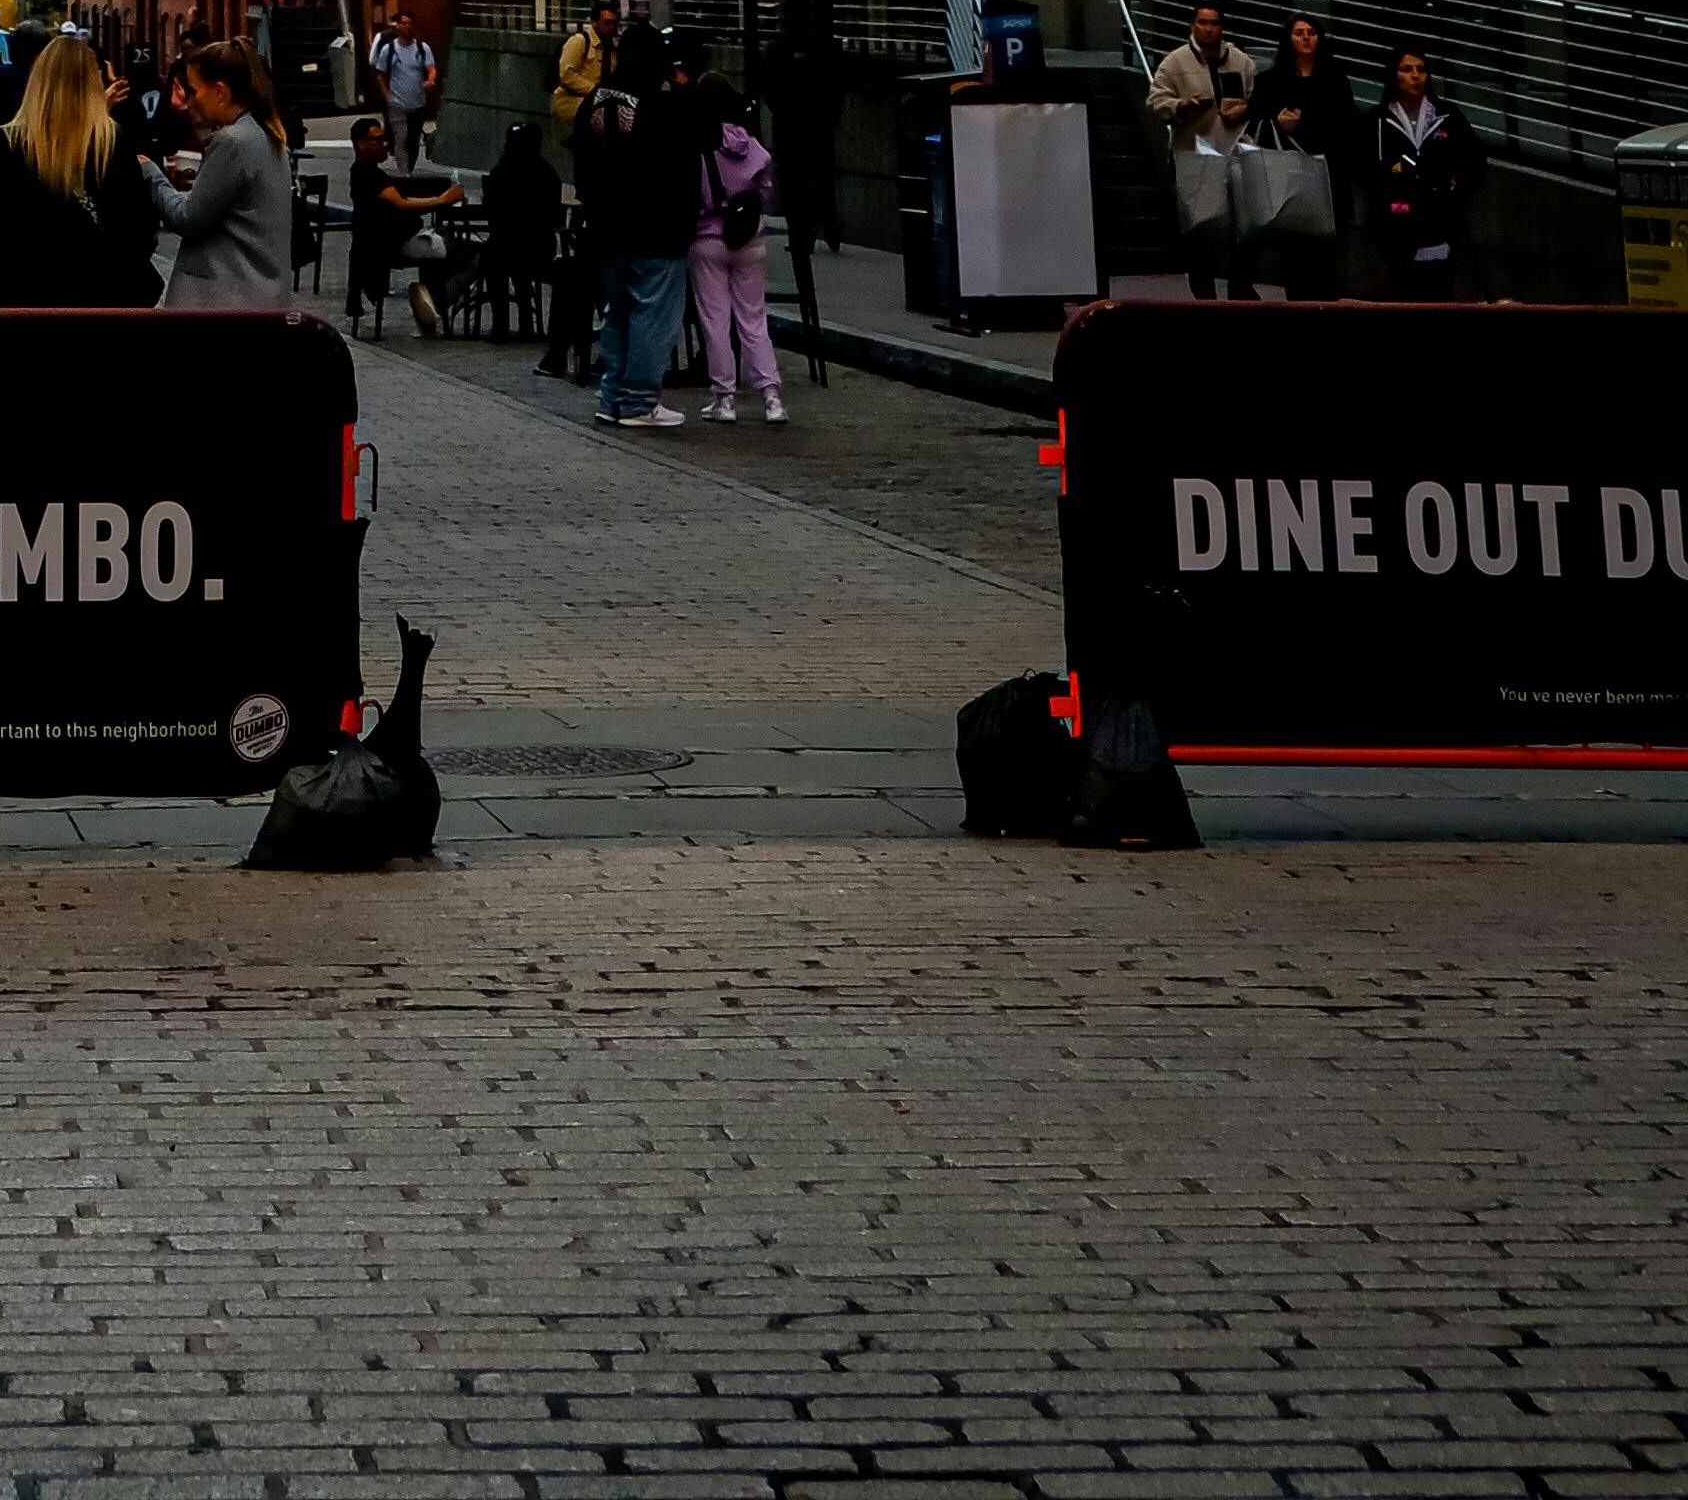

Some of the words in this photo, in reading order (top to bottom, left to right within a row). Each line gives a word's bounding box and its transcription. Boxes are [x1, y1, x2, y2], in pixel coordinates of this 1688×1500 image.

[1006, 37, 1024, 66] P
[1172, 478, 1379, 573] DINE
[1404, 480, 1571, 577] OUT
[1498, 686, 1551, 704] Youve
[1555, 690, 1602, 705] never
[1606, 687, 1646, 706] been
[45, 722, 62, 739] to
[66, 721, 98, 739] this
[102, 719, 217, 743] neighborhood
[235, 712, 284, 742] DUMBO
